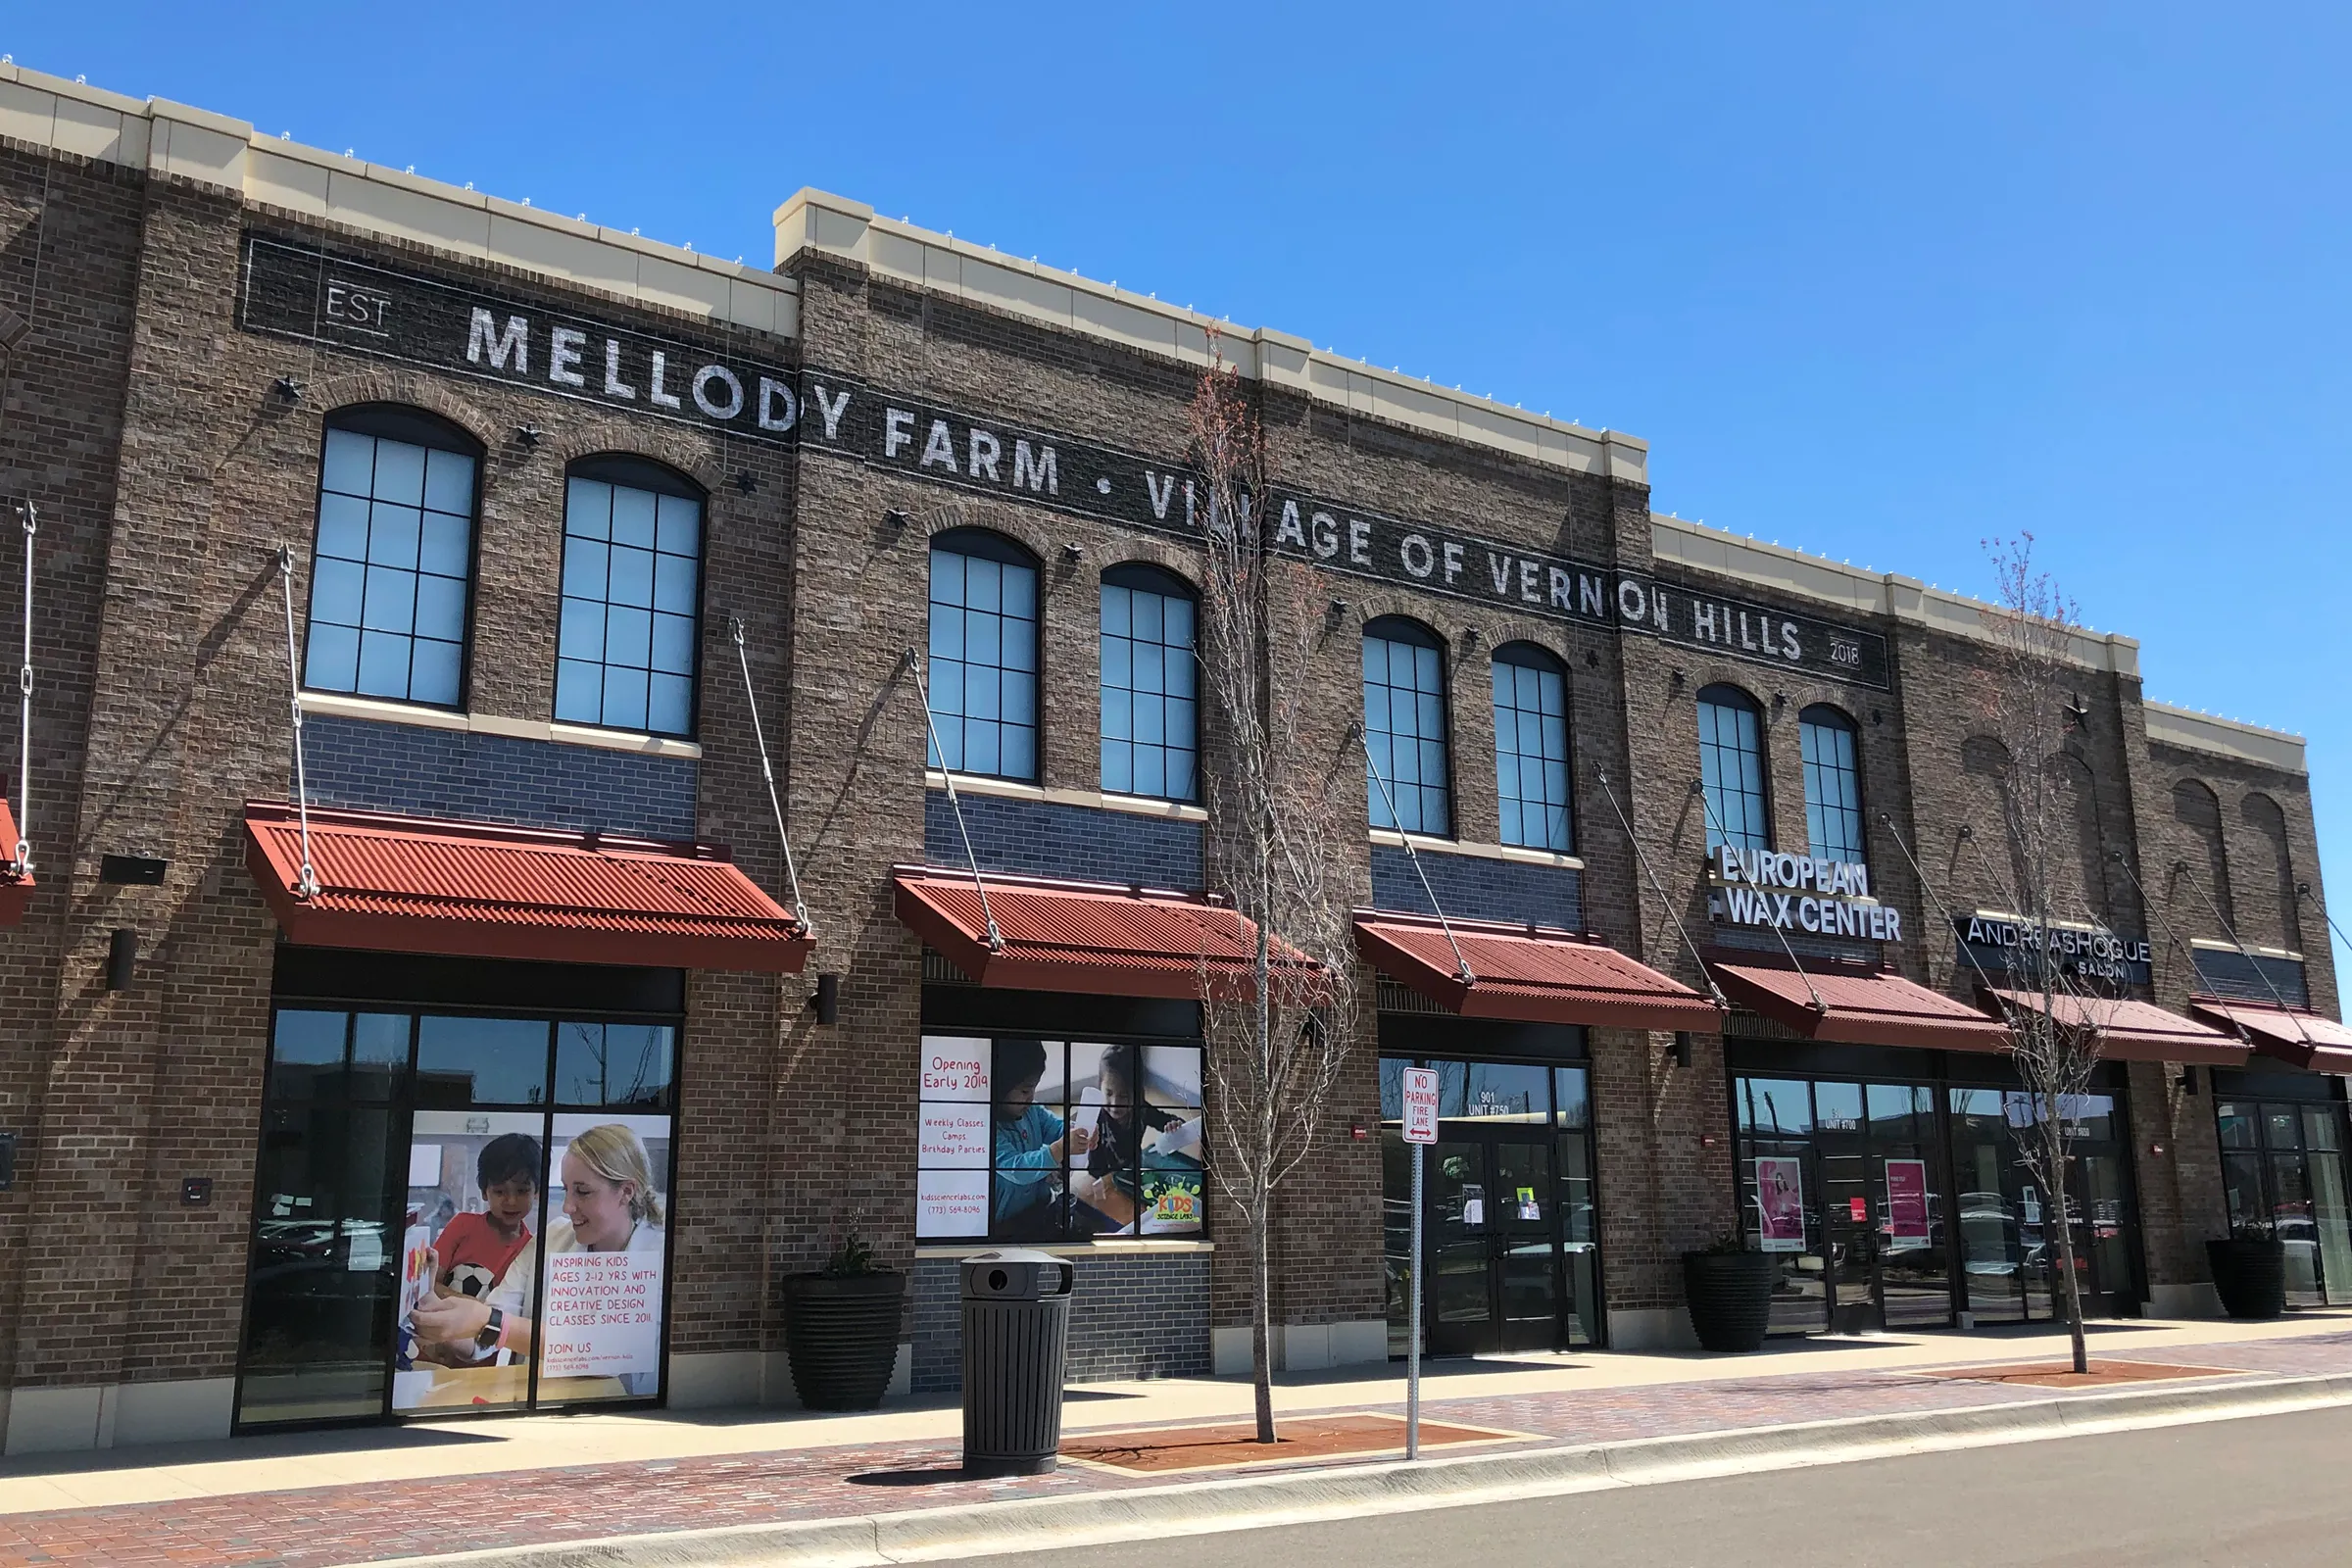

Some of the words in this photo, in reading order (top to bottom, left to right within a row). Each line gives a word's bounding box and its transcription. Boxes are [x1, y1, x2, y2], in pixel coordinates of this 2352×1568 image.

[325, 286, 390, 326] EST
[465, 306, 851, 440] MELLODY
[883, 407, 1059, 496] FARM
[1399, 534, 1464, 584] OF
[1488, 551, 1669, 632] VERNON
[1693, 599, 1801, 662] HILLS
[1830, 642, 1860, 664] 2018
[1722, 845, 1869, 897] EUROPEAN
[1726, 887, 1794, 930] WAX
[1798, 896, 1902, 942] CENTER
[2078, 961, 2125, 979] SALON
[932, 1056, 981, 1075] Opening
[924, 1073, 957, 1090] Early
[963, 1075, 988, 1089] 2019
[1414, 1075, 1428, 1089] NO
[1406, 1091, 1436, 1105] PARKING
[1480, 1091, 1494, 1103] 901
[1412, 1105, 1429, 1116] FIRE
[1468, 1103, 1489, 1116] UNIT
[1490, 1103, 1509, 1116] #750
[925, 1118, 954, 1128] Weekly
[1411, 1117, 1429, 1127] LANE
[921, 1144, 955, 1155] Birthday
[927, 1205, 947, 1215] (773)
[552, 1256, 602, 1268] INSPIRING
[606, 1256, 629, 1267] KIDS
[552, 1272, 580, 1283] AGES
[585, 1271, 604, 1282] 2-12
[608, 1270, 627, 1281] YRS
[632, 1270, 657, 1280] WITH
[551, 1286, 619, 1297] INNOVATION
[623, 1284, 646, 1295] AND
[550, 1299, 602, 1311] CREATIVE
[608, 1298, 645, 1310] DESIGN
[549, 1314, 596, 1326] CLASSES
[601, 1312, 630, 1324] SINCE
[548, 1344, 573, 1354] JOIN
